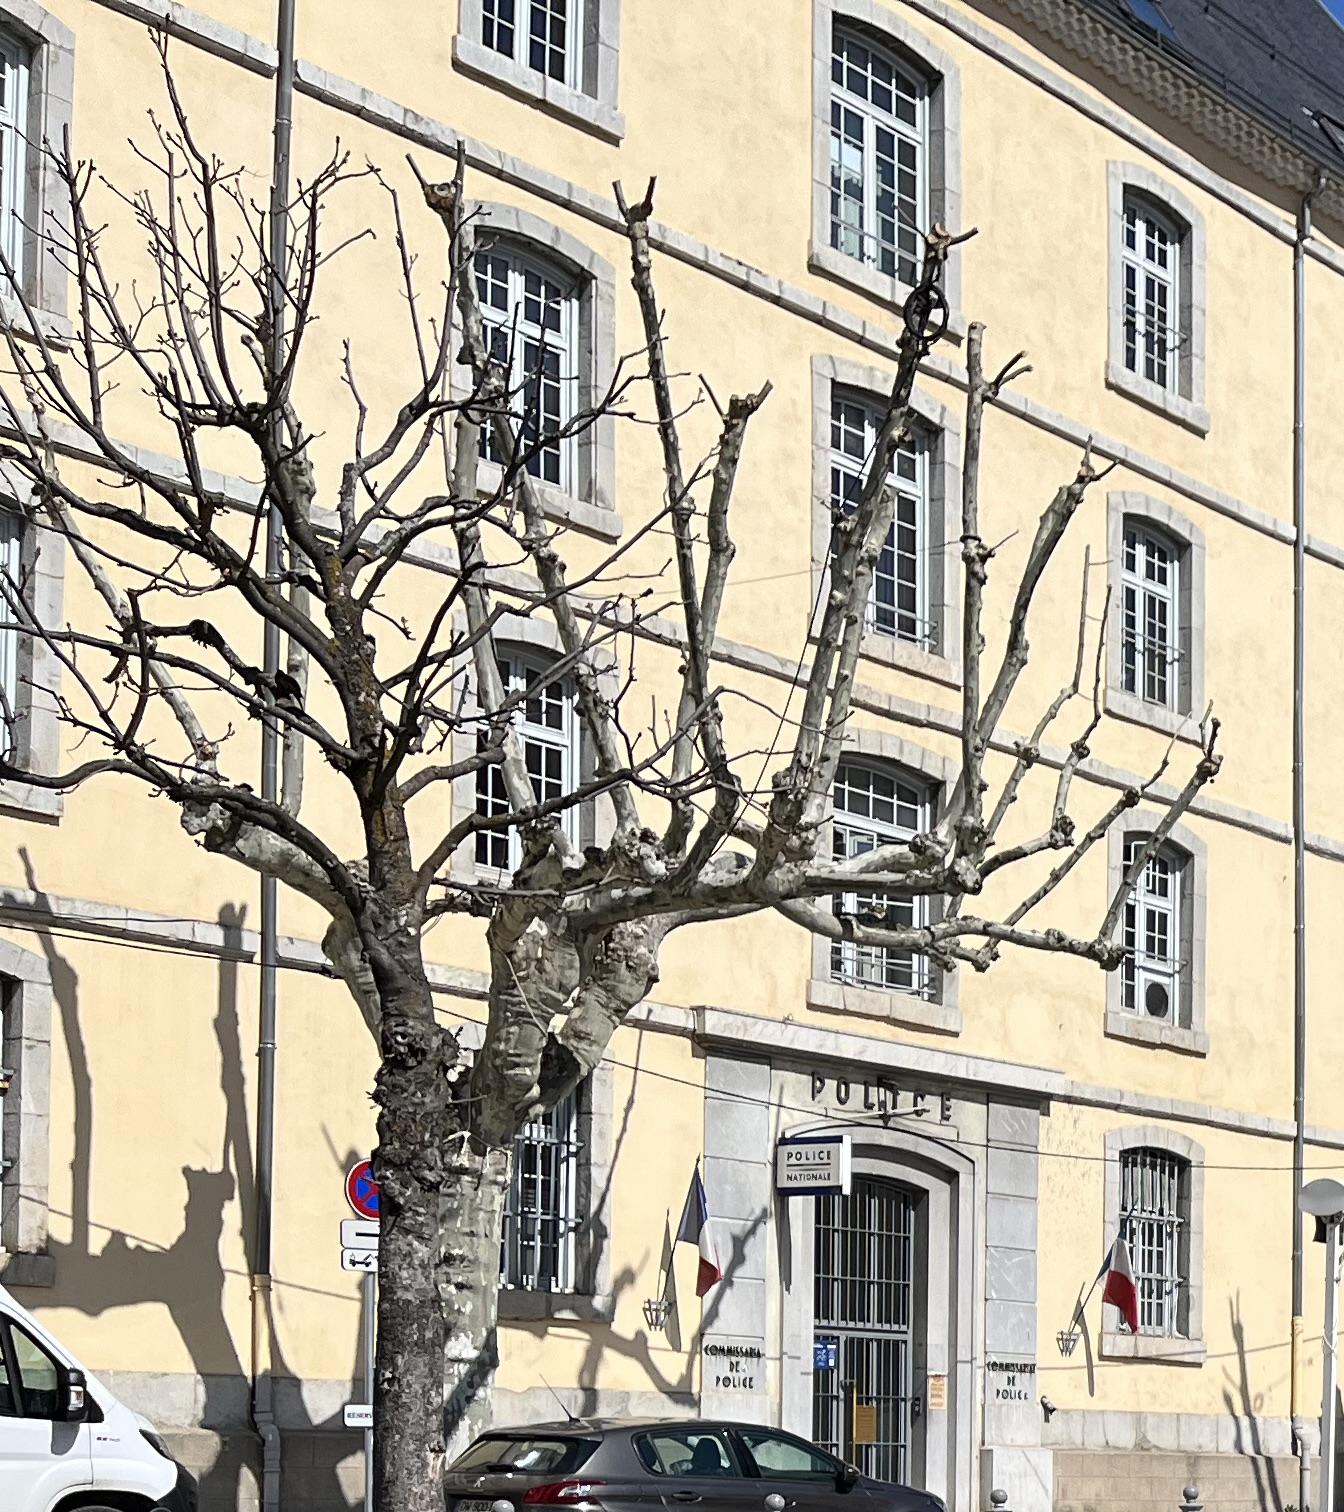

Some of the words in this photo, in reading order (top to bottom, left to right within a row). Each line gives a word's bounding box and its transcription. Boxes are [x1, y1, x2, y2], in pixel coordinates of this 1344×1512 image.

[811, 1071, 951, 1121] POLICE
[786, 1150, 831, 1161] POLICE
[786, 1172, 831, 1182] NATIONALE
[704, 1344, 765, 1358] COMMISSARIA
[729, 1361, 740, 1372] DE
[715, 1376, 753, 1389] POLICE
[1007, 1375, 1016, 1386] DE
[996, 1389, 1028, 1401] POLICE
